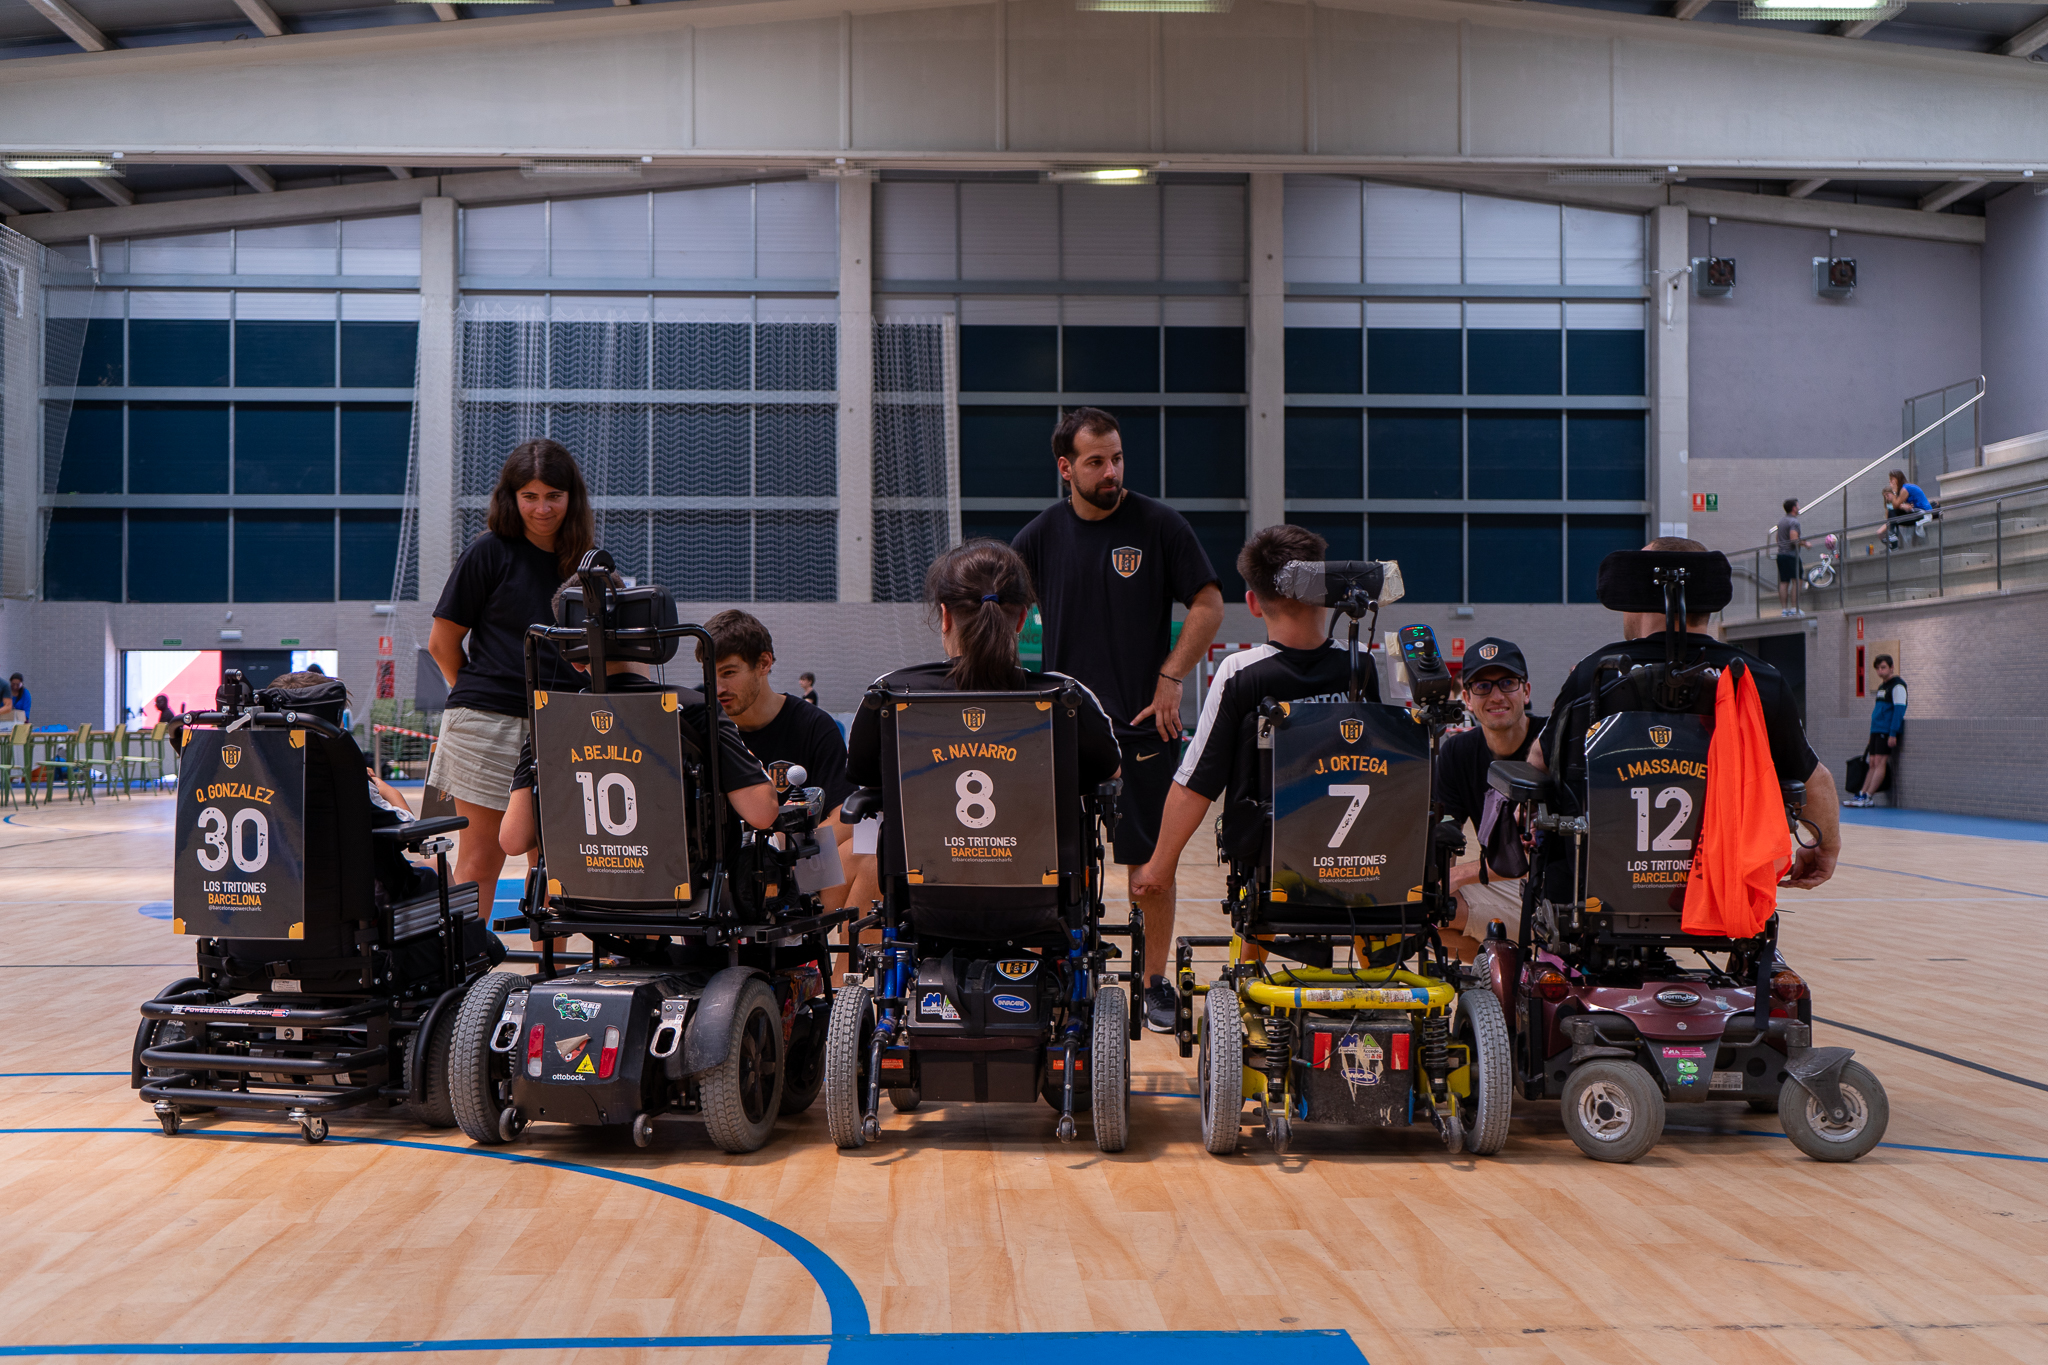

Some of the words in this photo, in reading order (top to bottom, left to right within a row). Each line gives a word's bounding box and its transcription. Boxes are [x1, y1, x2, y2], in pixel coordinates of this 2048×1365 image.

[571, 748, 583, 763] A.
[584, 745, 643, 764] BEJILLO
[931, 748, 948, 763] R.
[948, 742, 1017, 762] NAVARRO
[1314, 758, 1328, 775] J.
[1330, 755, 1388, 776] ORTEGA
[1617, 767, 1628, 782] I.
[1627, 759, 1708, 779] MASSAGUE
[196, 788, 207, 804] Q.
[208, 782, 275, 805] GONZALEZ
[955, 769, 996, 829] 8
[575, 771, 638, 836] 10
[1327, 784, 1370, 848] 7
[1630, 786, 1693, 851] 12
[196, 806, 269, 873] 30
[944, 837, 965, 847] LOS
[967, 836, 1018, 847] TRITONES
[579, 843, 599, 855] LOS
[600, 844, 649, 857] TRITONES
[951, 847, 1012, 858] BARCELONA
[585, 856, 645, 868] BARCELONA
[1313, 856, 1334, 867] LOS
[1336, 854, 1387, 867] TRITONES
[1627, 860, 1648, 872] LOS
[1650, 860, 1693, 871] TRITONE
[1319, 866, 1380, 878] BARCELONA
[203, 880, 221, 892] LOS
[222, 881, 267, 893] TRITONES
[208, 893, 262, 906] BARCELONA
[997, 999, 1025, 1008] INVACARE
[552, 1073, 586, 1081] ottobock.
